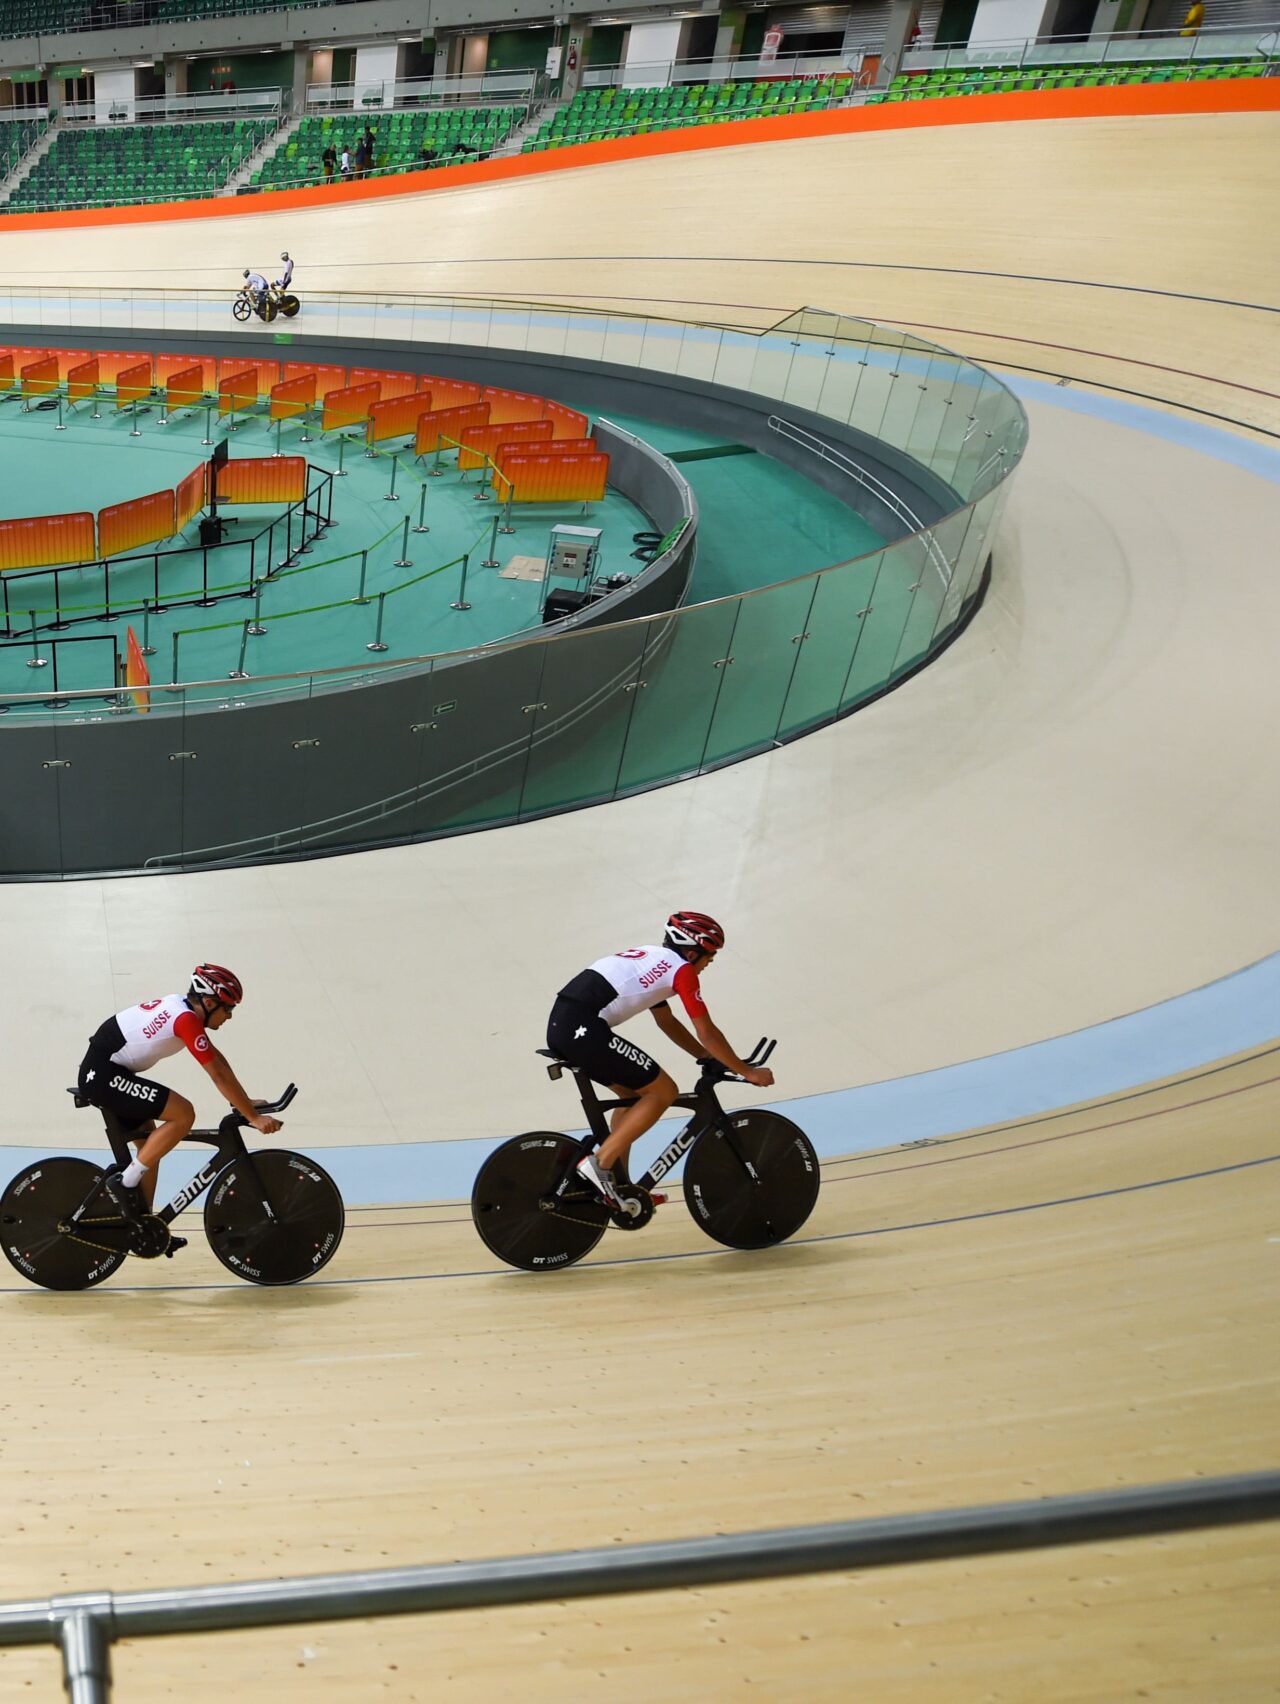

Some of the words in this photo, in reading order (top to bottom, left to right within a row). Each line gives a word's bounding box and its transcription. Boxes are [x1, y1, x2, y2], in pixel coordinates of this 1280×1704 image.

[639, 959, 673, 989] SUISSE
[142, 1009, 172, 1039] SUISSE
[608, 1036, 653, 1071] SUISSE
[109, 1075, 159, 1103] SUISSE
[647, 1126, 695, 1183] BMC
[745, 1161, 758, 1179] BMC
[170, 1162, 217, 1214] BMC
[262, 1200, 275, 1218] BMC
[695, 1197, 711, 1220] SWISS
[312, 1254, 322, 1264] DT
[321, 1233, 335, 1254] SWISS
[546, 1252, 569, 1264] SWISS
[17, 1257, 37, 1275] SWISS
[87, 1269, 99, 1280] DT
[98, 1255, 116, 1273] SWISS
[229, 1255, 241, 1266] DT
[240, 1263, 262, 1277] SWISS
